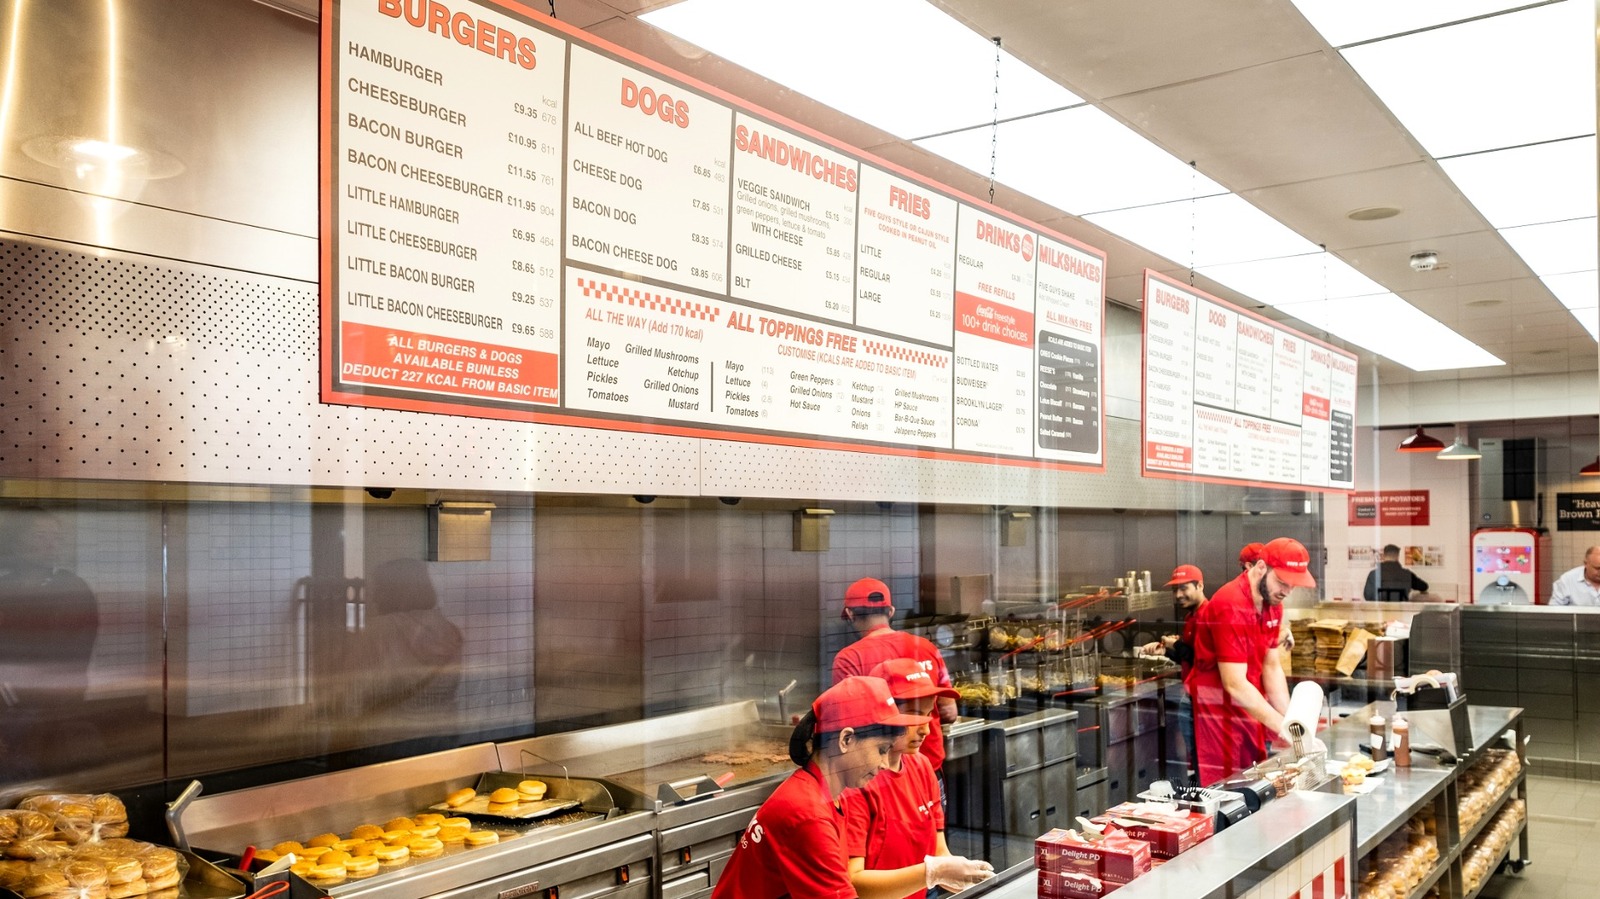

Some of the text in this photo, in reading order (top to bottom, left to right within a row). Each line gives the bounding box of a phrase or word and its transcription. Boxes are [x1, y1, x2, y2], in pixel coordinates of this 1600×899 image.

[349, 41, 443, 86] HAMBURGER
[348, 78, 466, 127] CHEESEBURGER
[621, 77, 689, 128] DOGS
[514, 103, 557, 125] £9.35 678
[348, 113, 463, 159] BACON BURGER
[508, 132, 555, 155] £10.95 811
[574, 122, 668, 163] ALL BEEF HOT DOG
[735, 124, 857, 193] SANDWICHES
[348, 149, 554, 216] BACON CHEESEBURGER £11.95 904
[507, 165, 554, 186] £11.55 761
[573, 159, 643, 190] CHEESE DOG
[694, 165, 711, 178] £6.85
[348, 184, 460, 224] LITTLE HAMBURGER
[693, 199, 710, 212] £7.85
[737, 191, 797, 219] Grilled grilled
[738, 178, 810, 211] VEGGIE SANDWICH
[890, 185, 930, 220] FRIES
[573, 197, 637, 225] BACON DOG
[736, 205, 826, 239] green lettuce tomato
[751, 222, 803, 246] WITH CHEESE
[864, 208, 949, 243] FIVE GUYS STYLE CAJUN STYLE
[879, 224, 927, 245] COOKED PEANUT
[977, 219, 1020, 253] DRINKS
[348, 220, 477, 261] LITTLE CHEESEBURGER
[512, 229, 554, 246] £6.95 464
[692, 233, 709, 245] £8.35
[572, 235, 709, 279] BACON CHEESE DOG £8.85
[735, 244, 802, 271] GRILLED CHEESE
[861, 244, 881, 258] LITTLE
[959, 254, 983, 270] REGULAR
[348, 256, 475, 293] LITTLE BACON BURGER
[512, 261, 554, 278] £8.65 512
[1040, 244, 1100, 283] MILKSHAKES
[735, 276, 751, 288] BLT
[860, 267, 890, 283] REGULAR
[512, 292, 553, 308] £9.25 537
[860, 289, 881, 303] LARGE
[978, 282, 1015, 300] FREE REFILLS
[1156, 288, 1189, 315] BURGERS
[348, 292, 535, 335] LITTLE BACON CHEESEBURGER £9.65
[1209, 309, 1227, 328] DOGS
[586, 308, 703, 343] ALL THE WAY (Add 170 kcal)
[727, 311, 857, 353] ALL TOPPINGS FREE
[962, 314, 980, 328] 100+
[982, 320, 1000, 334] drink
[1002, 326, 1028, 342] choices
[1238, 320, 1273, 345] SANDWICHES
[389, 335, 522, 364] ALL BURGERS & DOGS
[587, 337, 699, 364] Mayo Grilled Mushrooms
[1283, 338, 1296, 354] FRIES
[393, 353, 519, 379] AVAILABLE BUNLESS
[587, 354, 699, 381] Lettuce Ketchup
[725, 361, 744, 372] Mayo
[778, 344, 901, 376] CUSTOMISE (KCALS ARE ADDED BASIC
[957, 356, 998, 372] BOTTLED WATER
[343, 364, 558, 399] DEDUCT 227 KCAL FROM BASIC ITEM
[587, 371, 699, 395] Pickles Grilled Onions
[725, 376, 751, 387] Lettuce
[790, 371, 834, 386] Green Peppers
[852, 381, 874, 393] Ketchup
[956, 377, 986, 389] BUDWEISER
[587, 388, 699, 411] Tomatoes Mustard
[725, 391, 750, 402] Pickles
[790, 385, 832, 399] Grilled Onions
[852, 395, 873, 405] Mustard
[912, 391, 939, 402] Mushrooms
[725, 406, 758, 418] Tomatoes
[790, 400, 820, 411] Hot Sauce
[852, 408, 871, 418] Onions
[903, 402, 917, 411] Sauce
[956, 397, 1002, 411] BROOKLYN LAGER
[852, 421, 868, 431] Relish
[921, 418, 935, 426] Sauce
[956, 417, 978, 427] CORONA
[1560, 510, 1593, 518] Brown
[1062, 849, 1087, 859] Delight
[1065, 880, 1089, 891] Delight
